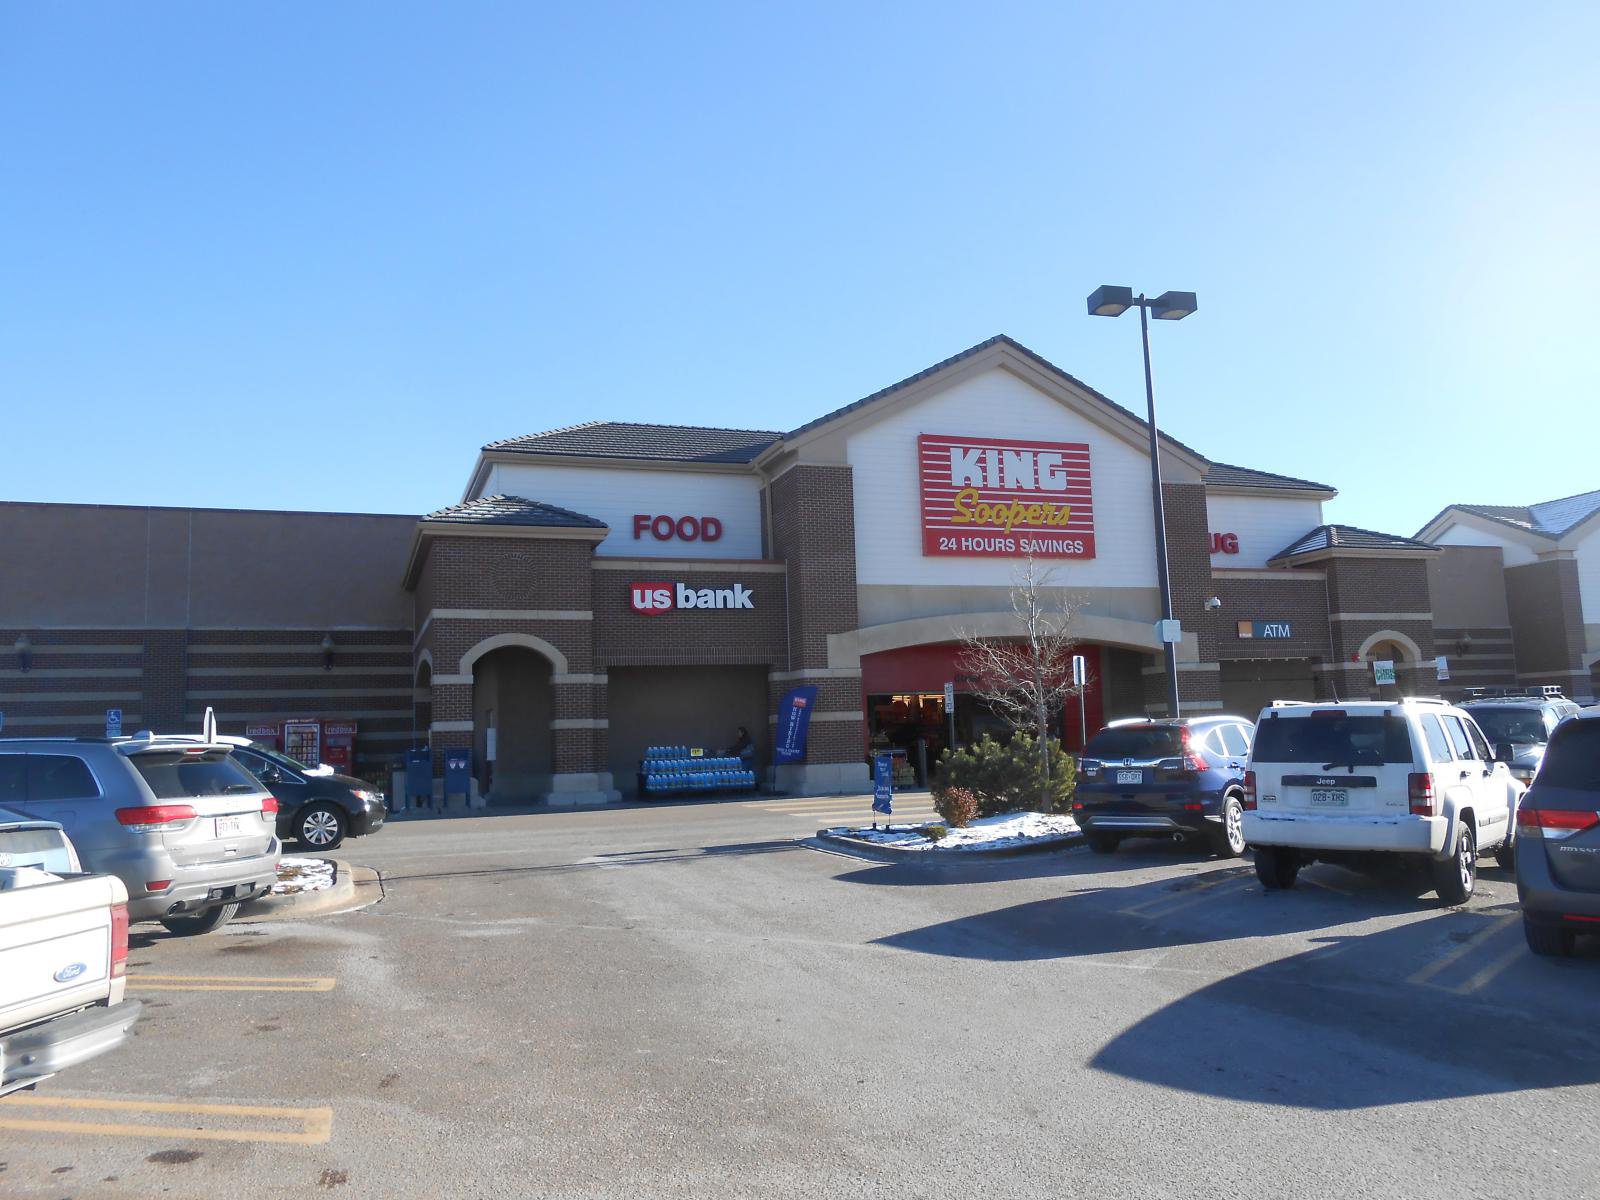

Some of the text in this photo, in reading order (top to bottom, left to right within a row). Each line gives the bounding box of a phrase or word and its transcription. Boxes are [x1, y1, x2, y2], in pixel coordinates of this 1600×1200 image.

[950, 447, 1068, 490] KING
[951, 488, 1071, 534] Soopers
[633, 514, 723, 541] FOOD
[939, 537, 1084, 553] 24 HOURS SAVINGS
[633, 583, 755, 609] us bank
[1263, 624, 1290, 637] ATM
[248, 727, 275, 735] redbox
